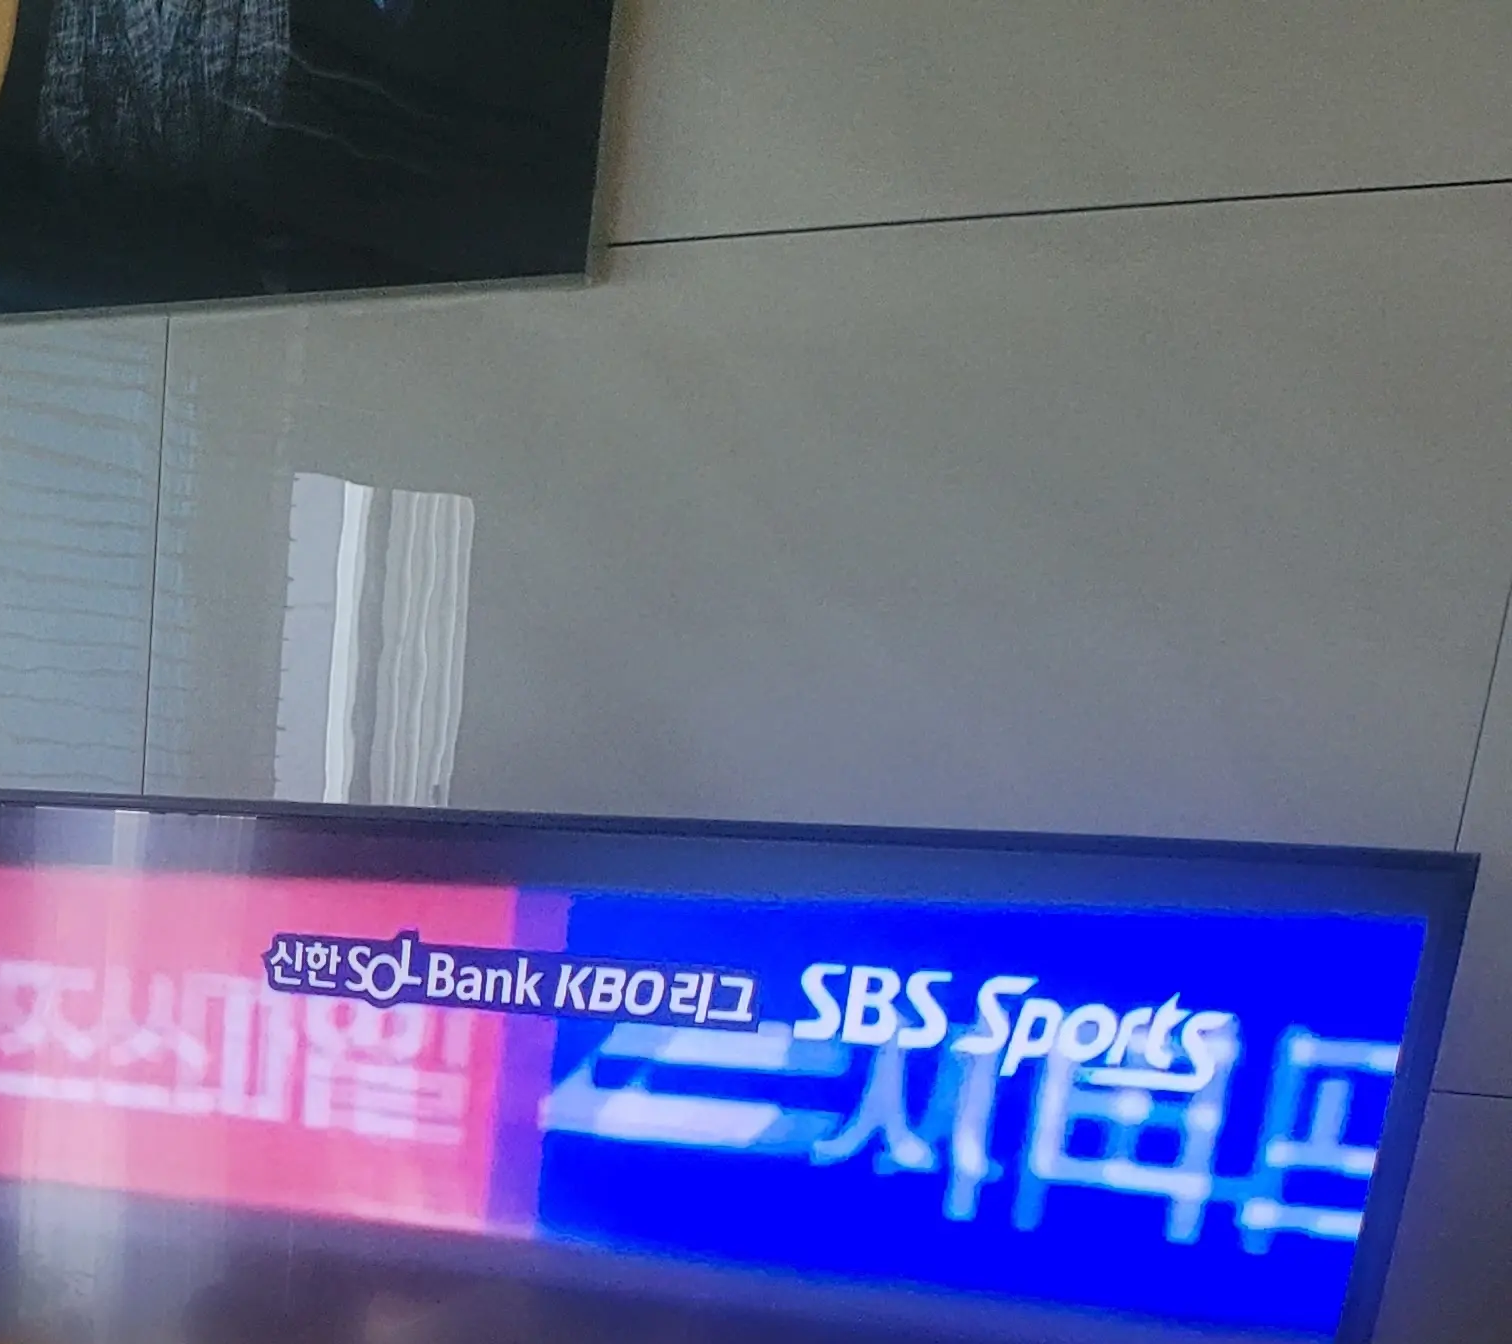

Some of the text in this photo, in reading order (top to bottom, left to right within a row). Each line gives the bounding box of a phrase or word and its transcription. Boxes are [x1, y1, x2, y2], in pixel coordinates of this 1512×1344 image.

[269, 940, 342, 989] 신한
[345, 938, 423, 1001] SOL
[425, 951, 542, 1008] Bank
[792, 962, 1238, 1093] SBS Sports
